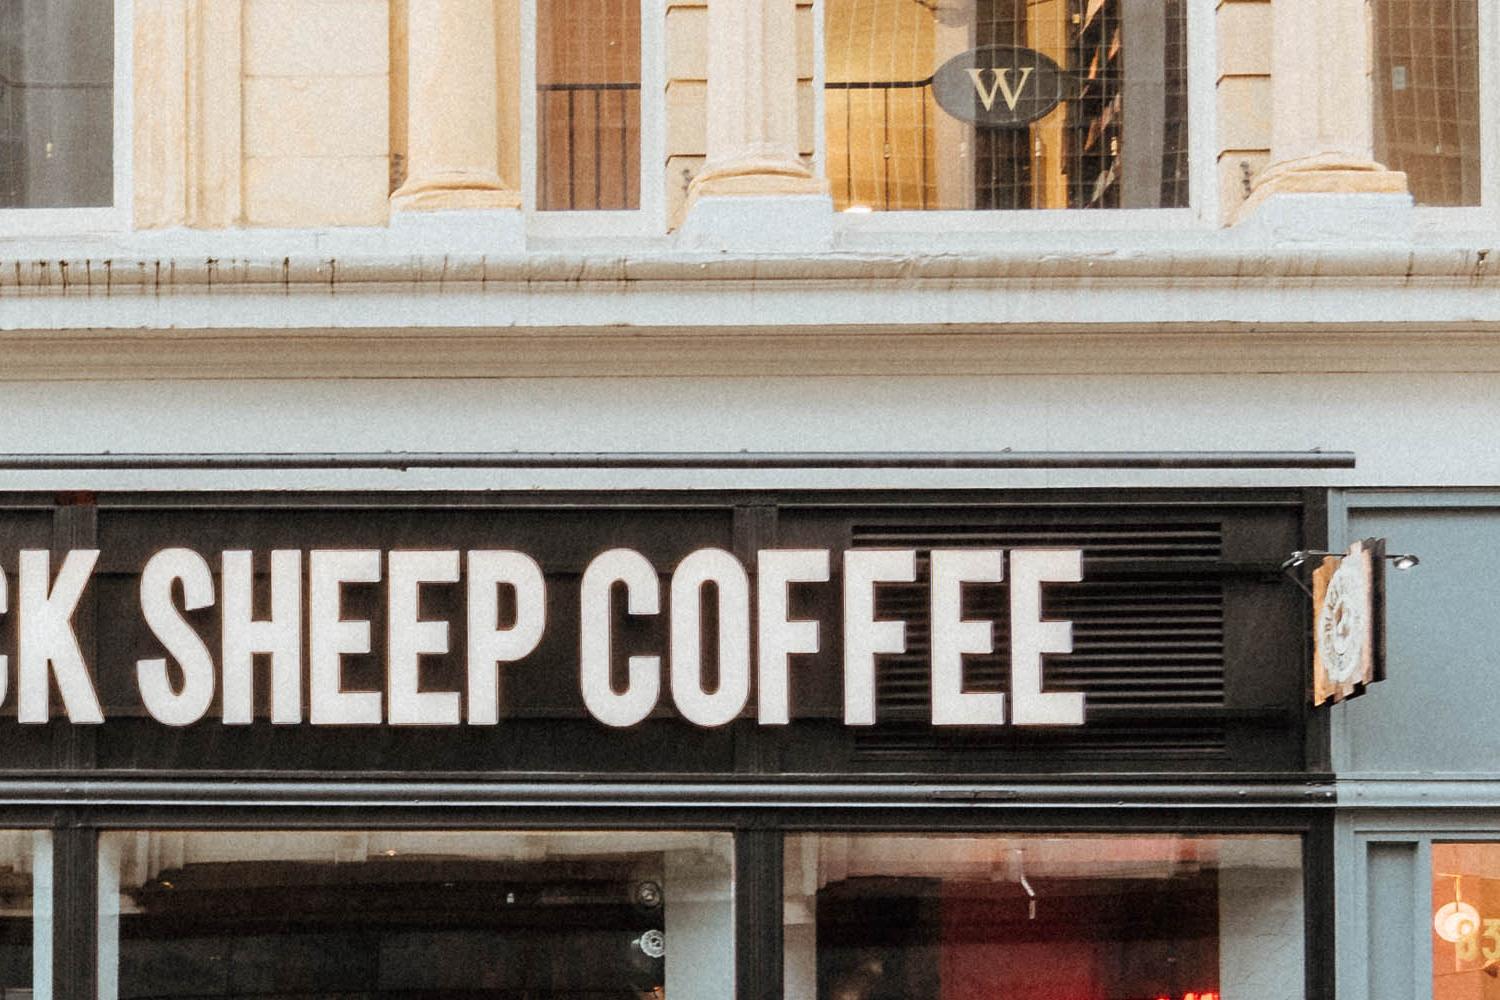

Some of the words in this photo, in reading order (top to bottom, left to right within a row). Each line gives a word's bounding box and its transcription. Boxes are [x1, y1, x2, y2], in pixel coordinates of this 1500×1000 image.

[964, 66, 1035, 112] W
[136, 547, 547, 727] SHEEP
[580, 547, 1087, 728] COFFEE
